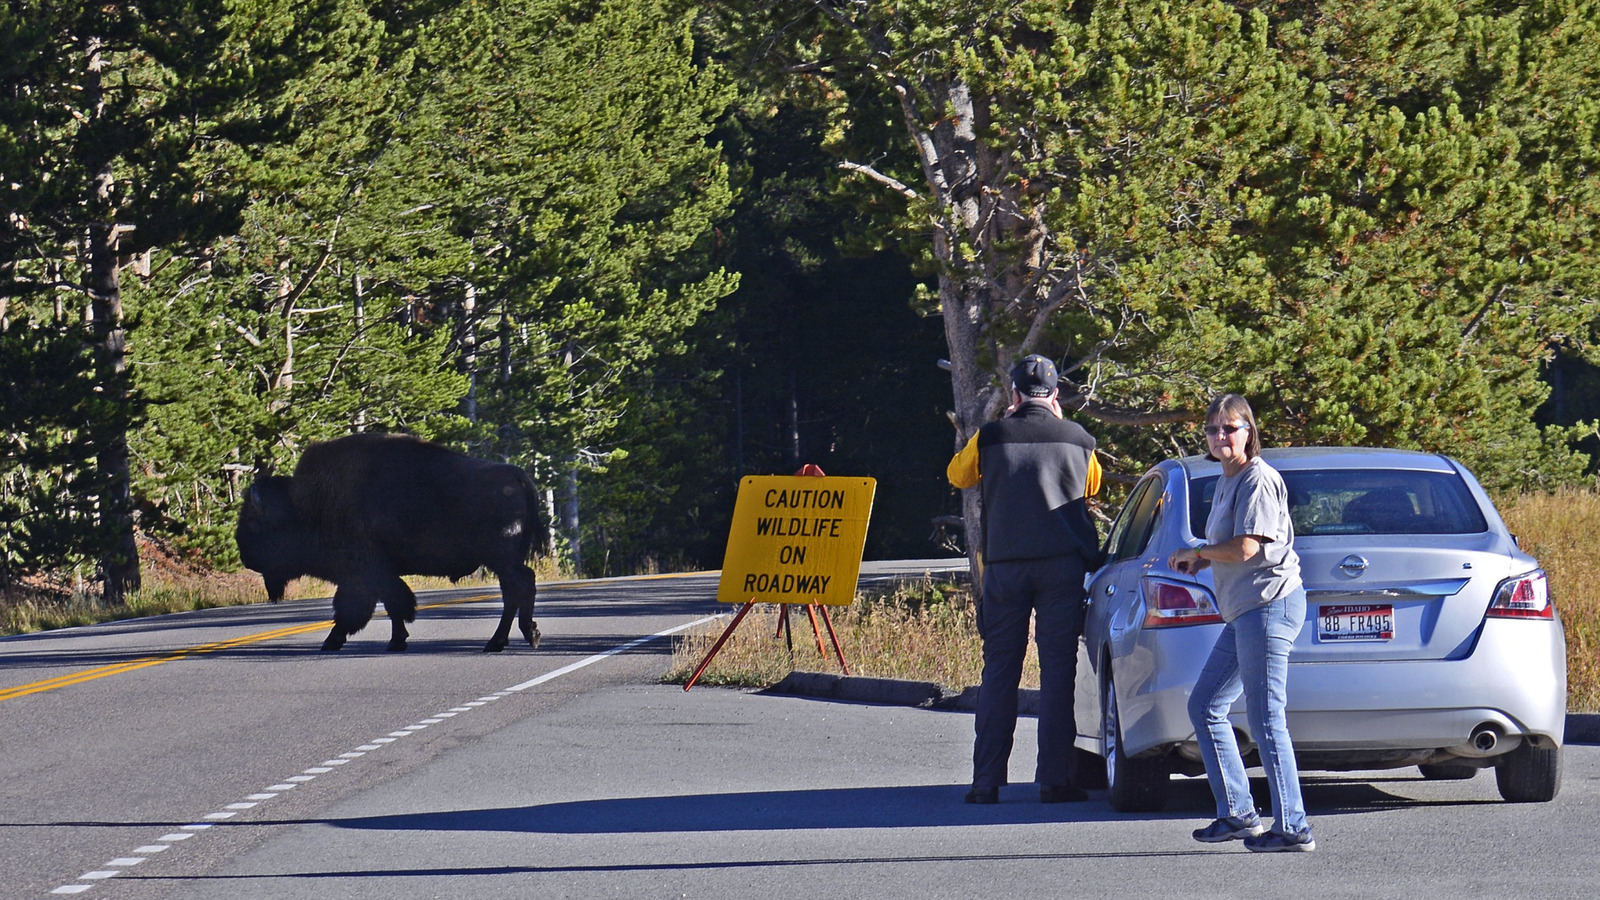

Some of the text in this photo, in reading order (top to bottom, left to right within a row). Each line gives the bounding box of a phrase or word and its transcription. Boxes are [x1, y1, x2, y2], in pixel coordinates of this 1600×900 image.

[765, 489, 844, 509] CAUTION
[757, 517, 842, 537] WILDLIFE
[779, 546, 806, 565] ON
[743, 574, 831, 594] ROADWAY
[1325, 615, 1390, 632] 8B FR495
